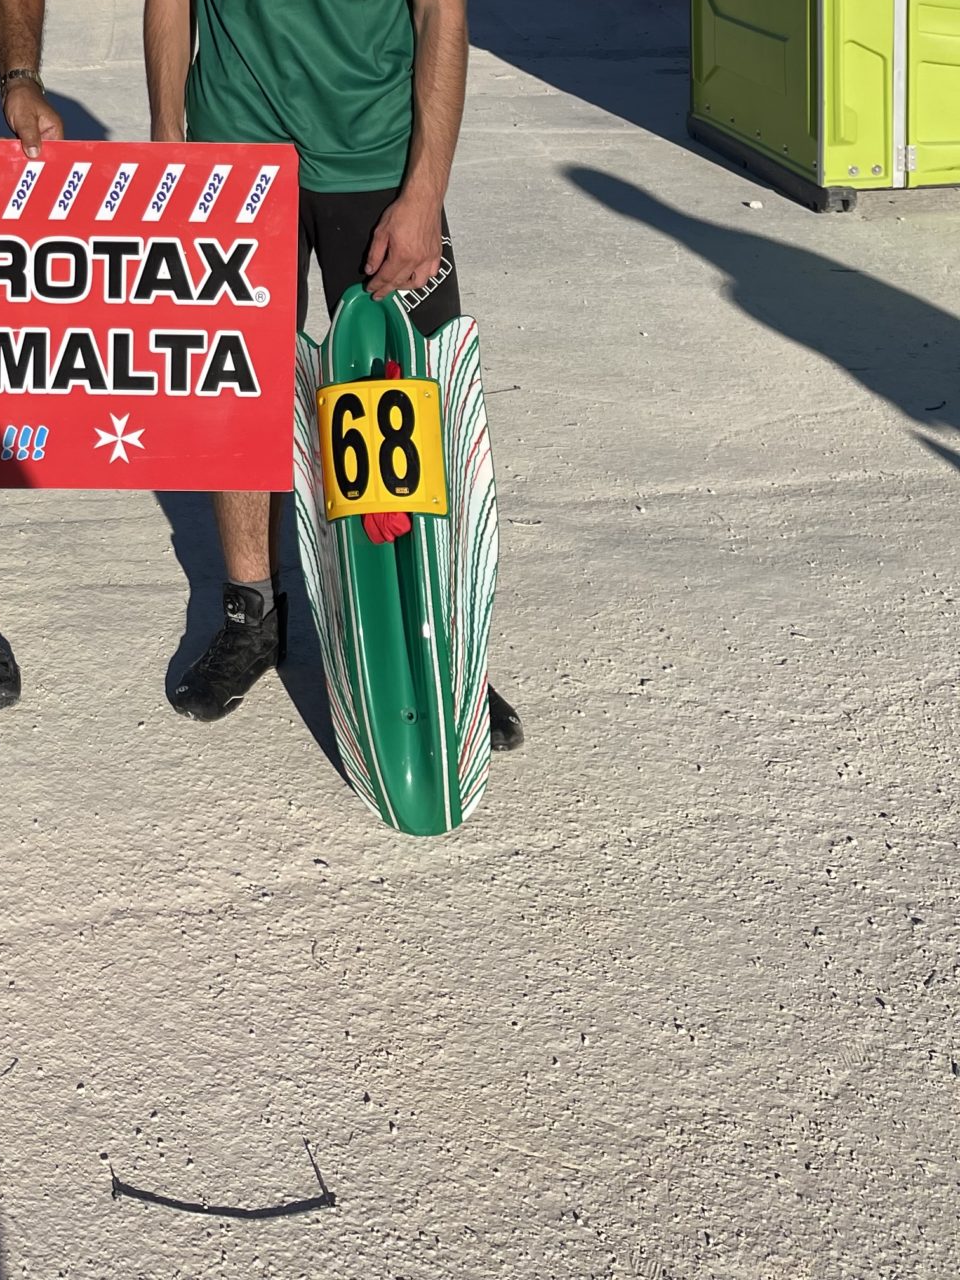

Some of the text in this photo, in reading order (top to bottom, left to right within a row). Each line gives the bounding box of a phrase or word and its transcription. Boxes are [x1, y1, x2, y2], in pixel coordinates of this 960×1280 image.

[11, 169, 37, 210] 2022
[58, 170, 84, 211] 2022
[105, 171, 131, 212] 2022
[151, 172, 177, 213] 2022
[198, 172, 224, 214] 2022
[245, 173, 271, 214] 2022
[332, 389, 420, 501] 68
